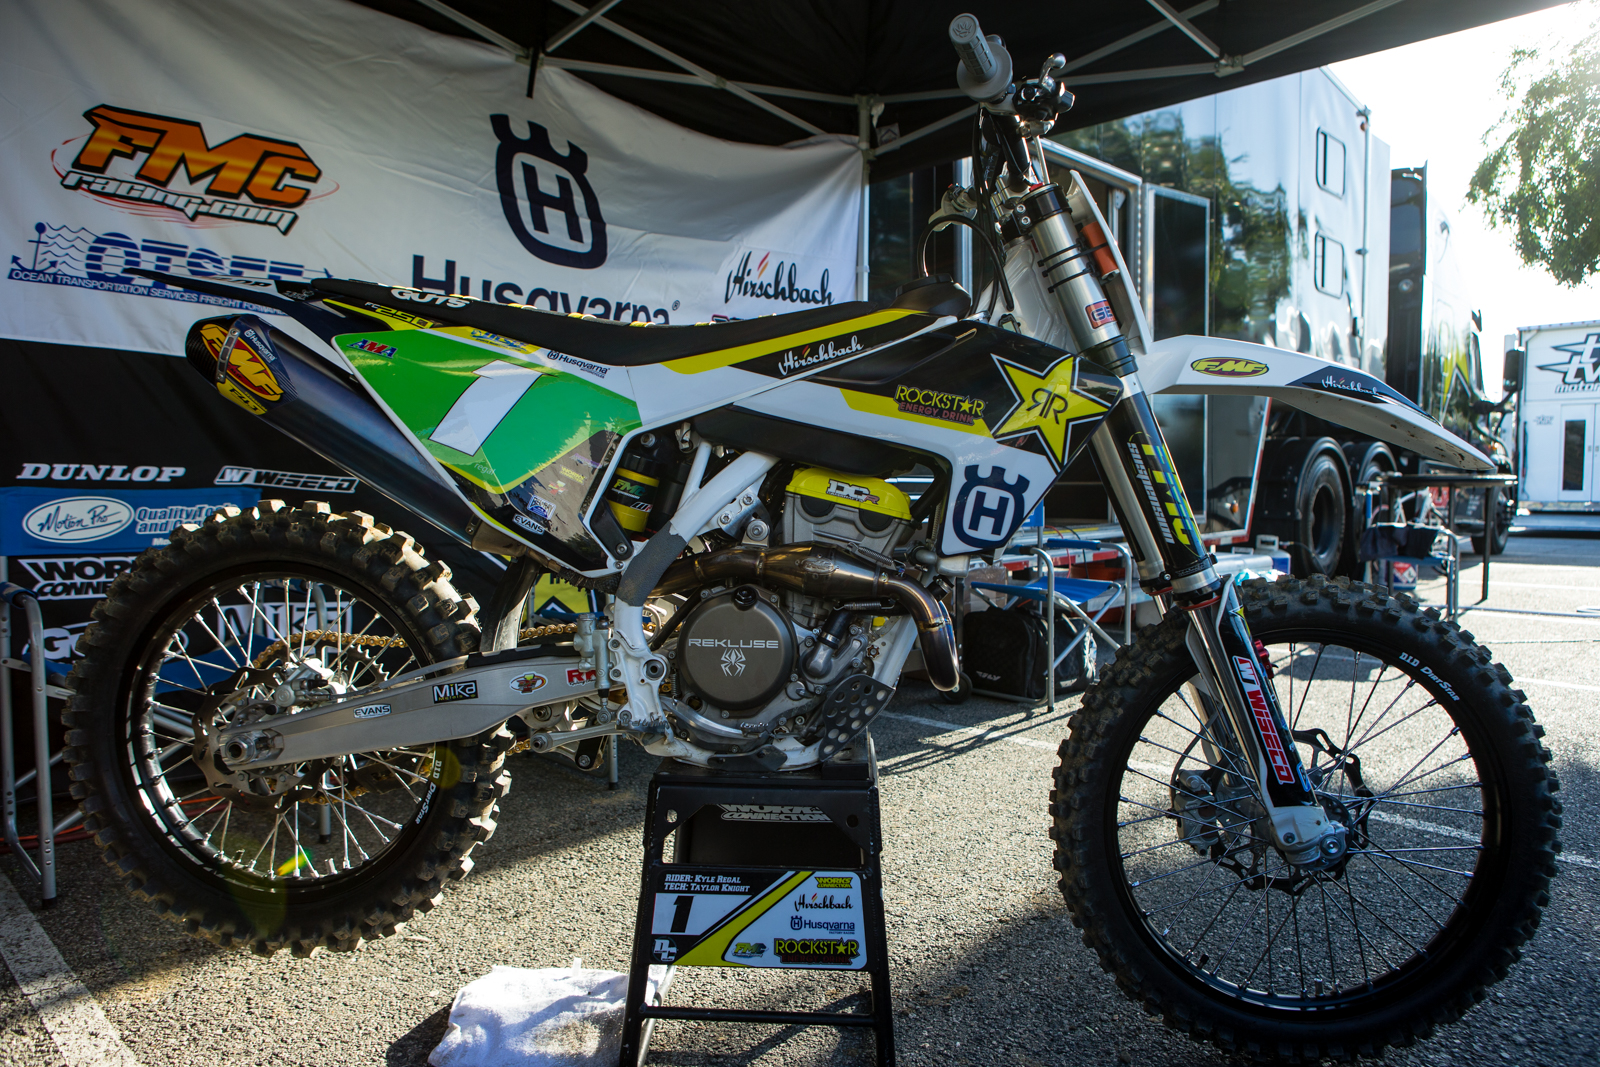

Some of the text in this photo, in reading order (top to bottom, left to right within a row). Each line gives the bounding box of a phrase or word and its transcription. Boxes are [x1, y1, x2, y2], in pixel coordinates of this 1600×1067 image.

[71, 104, 322, 209] FMC
[61, 170, 298, 236] racing.com
[724, 250, 836, 306] Hirschbach
[12, 270, 54, 283] OCEAN
[56, 275, 149, 295] TRANSPORTATION
[150, 287, 199, 303] SERVICES
[199, 292, 242, 308] FREIGHT
[391, 288, 470, 308] GUTS
[375, 305, 434, 329] 250
[346, 338, 398, 359] AMA
[778, 335, 864, 376] Hirschbach
[558, 354, 609, 375] Husqvarna
[1195, 360, 1268, 375] FMF
[428, 359, 546, 457] 1
[900, 402, 974, 424] ENERGY DRINK
[16, 463, 186, 482] DUNLOP
[1127, 442, 1176, 545] suspension
[37, 504, 121, 533] Motion Pro
[136, 507, 198, 521] Quality
[514, 514, 545, 533] EVANS
[137, 520, 170, 534] and
[26, 560, 138, 581] WOR
[688, 638, 779, 649] REKLUSE
[354, 705, 391, 718] EVANS
[664, 882, 750, 892] TECH: TAYLOR KNIGHT
[665, 874, 741, 884] RIDER: KYLE REGAL
[794, 893, 854, 912] Hirschbach
[670, 895, 694, 933] 1
[804, 920, 855, 931] Husqvarna
[733, 942, 767, 954] FMC
[781, 955, 852, 963] ENERGY DRINK
